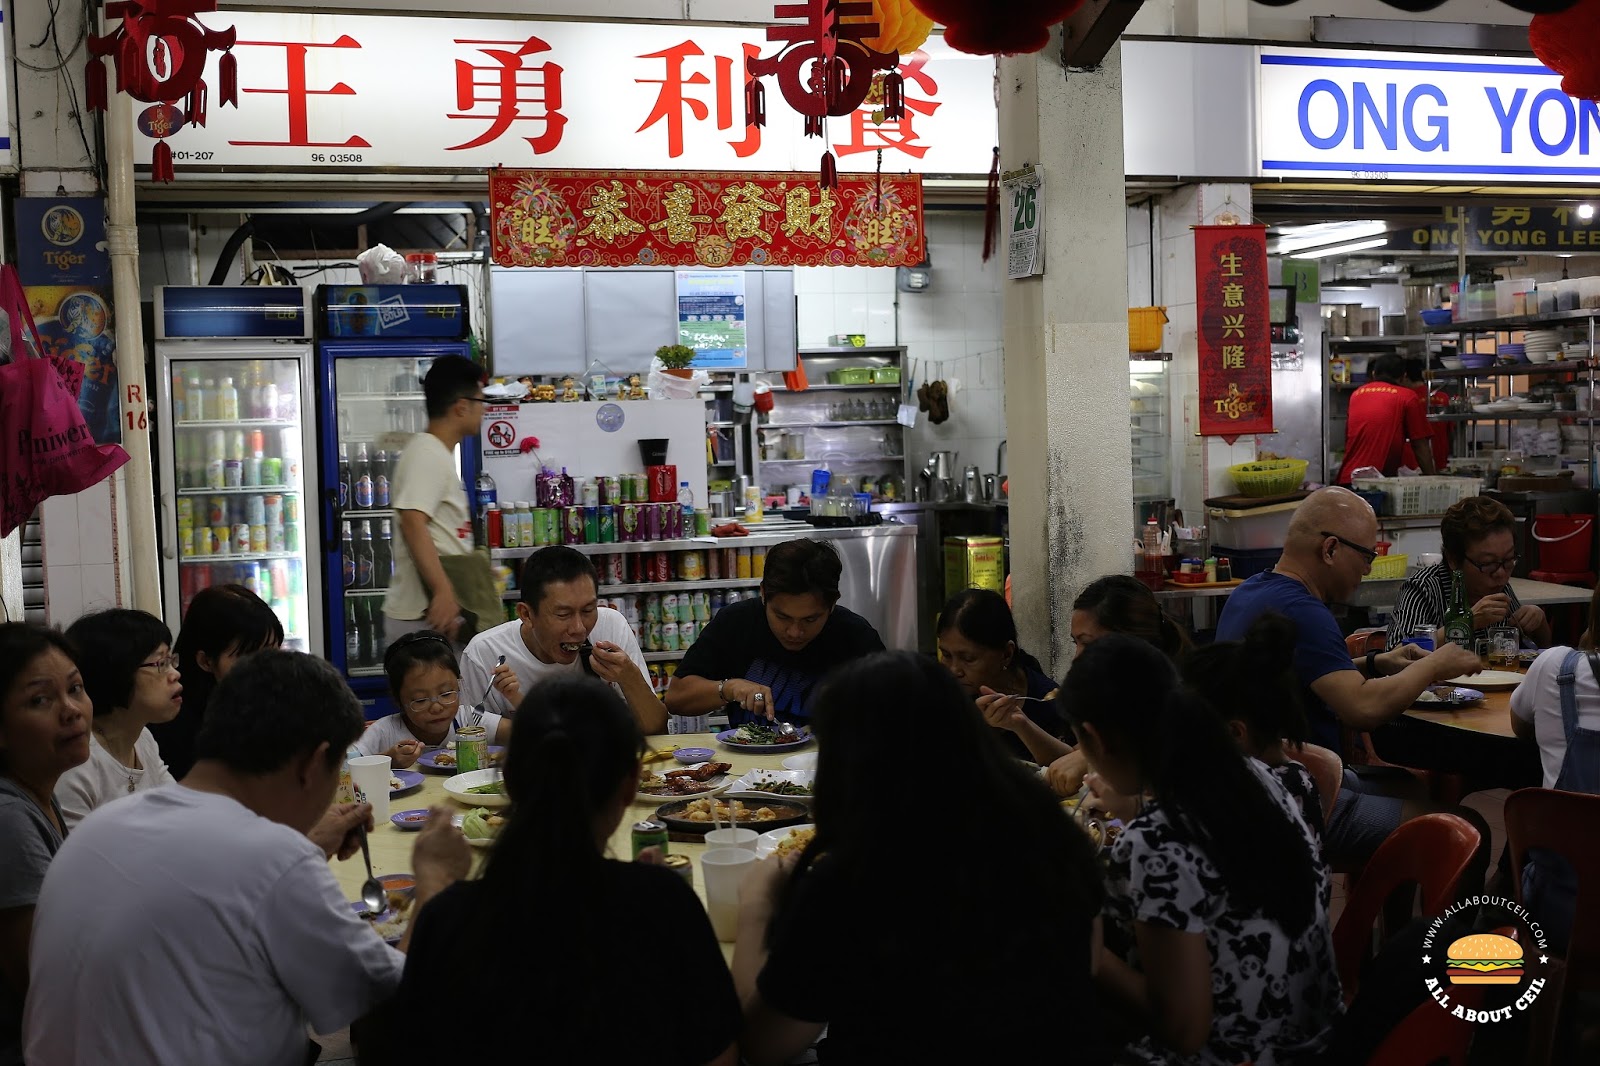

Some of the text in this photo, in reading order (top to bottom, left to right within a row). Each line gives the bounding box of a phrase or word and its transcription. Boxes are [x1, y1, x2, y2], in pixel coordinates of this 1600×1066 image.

[1297, 78, 1450, 152] ONG
[148, 119, 174, 134] Tiger
[171, 151, 214, 160] #01-207
[311, 154, 363, 162] 96 03508
[577, 179, 837, 245] 恭喜發財
[1013, 187, 1037, 232] 26
[1477, 230, 1547, 245] YONG
[1557, 230, 1600, 245] LEE
[43, 251, 86, 270] Tiger
[1220, 252, 1246, 370] 生意兴隆
[127, 384, 142, 404] R
[1213, 396, 1256, 419] Tiger
[126, 411, 147, 430] 16
